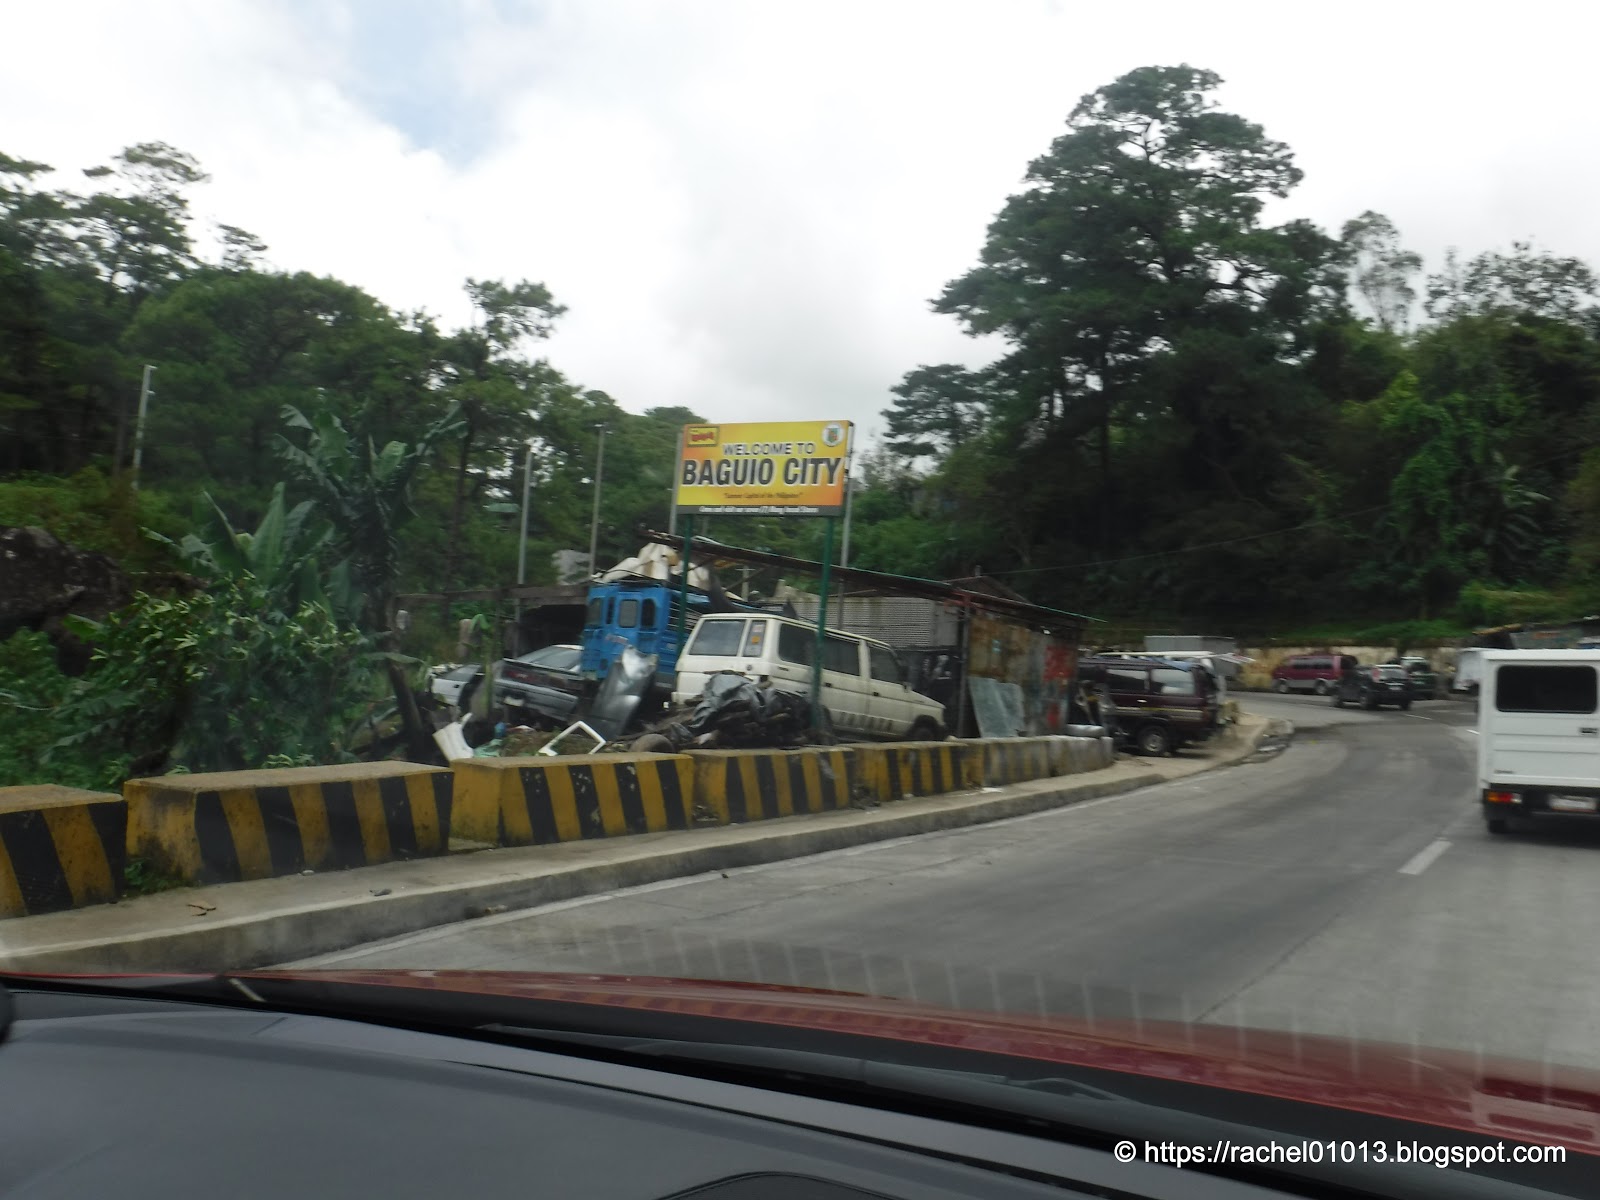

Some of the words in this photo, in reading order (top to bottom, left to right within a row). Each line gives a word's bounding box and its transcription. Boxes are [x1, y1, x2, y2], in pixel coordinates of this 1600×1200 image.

[723, 443, 792, 456] WELCOME
[797, 442, 815, 454] TO
[682, 459, 774, 486] BAGUIO
[783, 457, 842, 486] CITY
